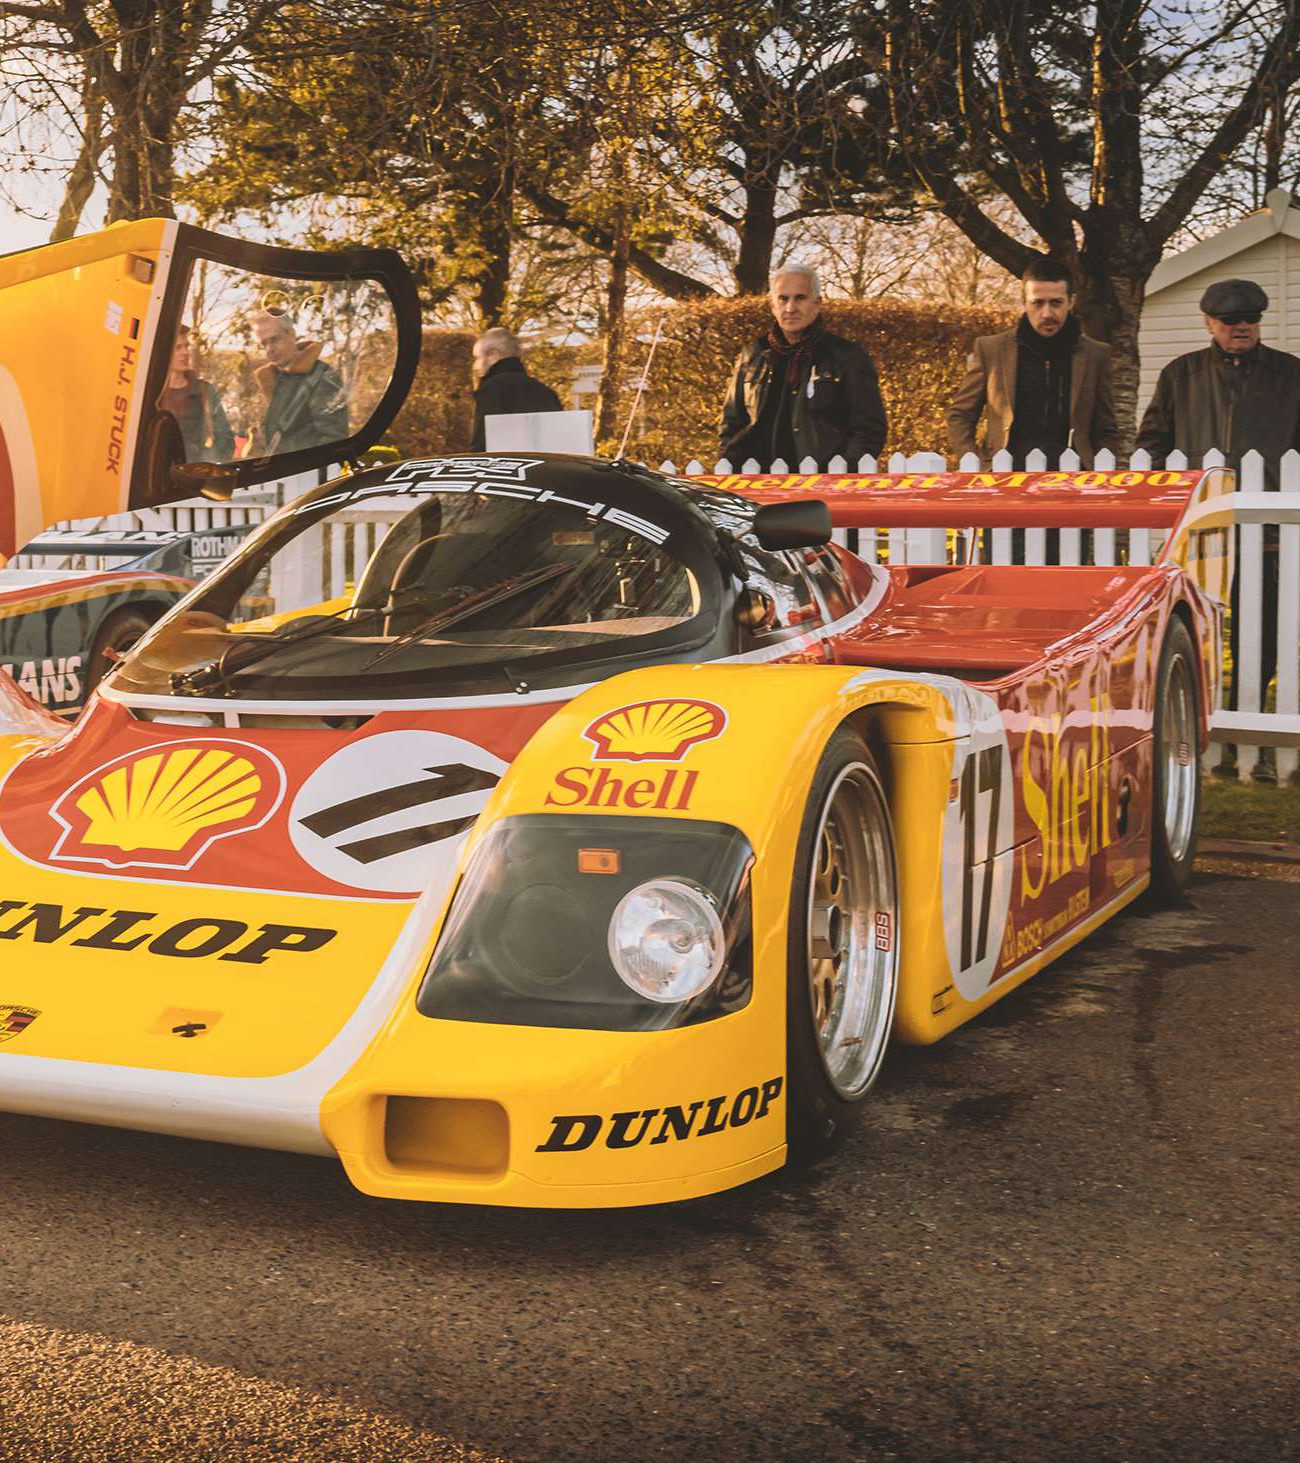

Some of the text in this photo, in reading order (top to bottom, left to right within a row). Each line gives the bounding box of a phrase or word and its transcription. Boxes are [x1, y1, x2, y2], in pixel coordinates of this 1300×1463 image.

[106, 395, 128, 476] STUCK
[834, 474, 943, 489] mit
[191, 536, 248, 557] ROTHM
[544, 766, 700, 811] Shell
[1021, 692, 1112, 908] Shell
[959, 744, 1003, 973] 17
[876, 912, 889, 952] BBS
[534, 1076, 784, 1153] DUNLOP
